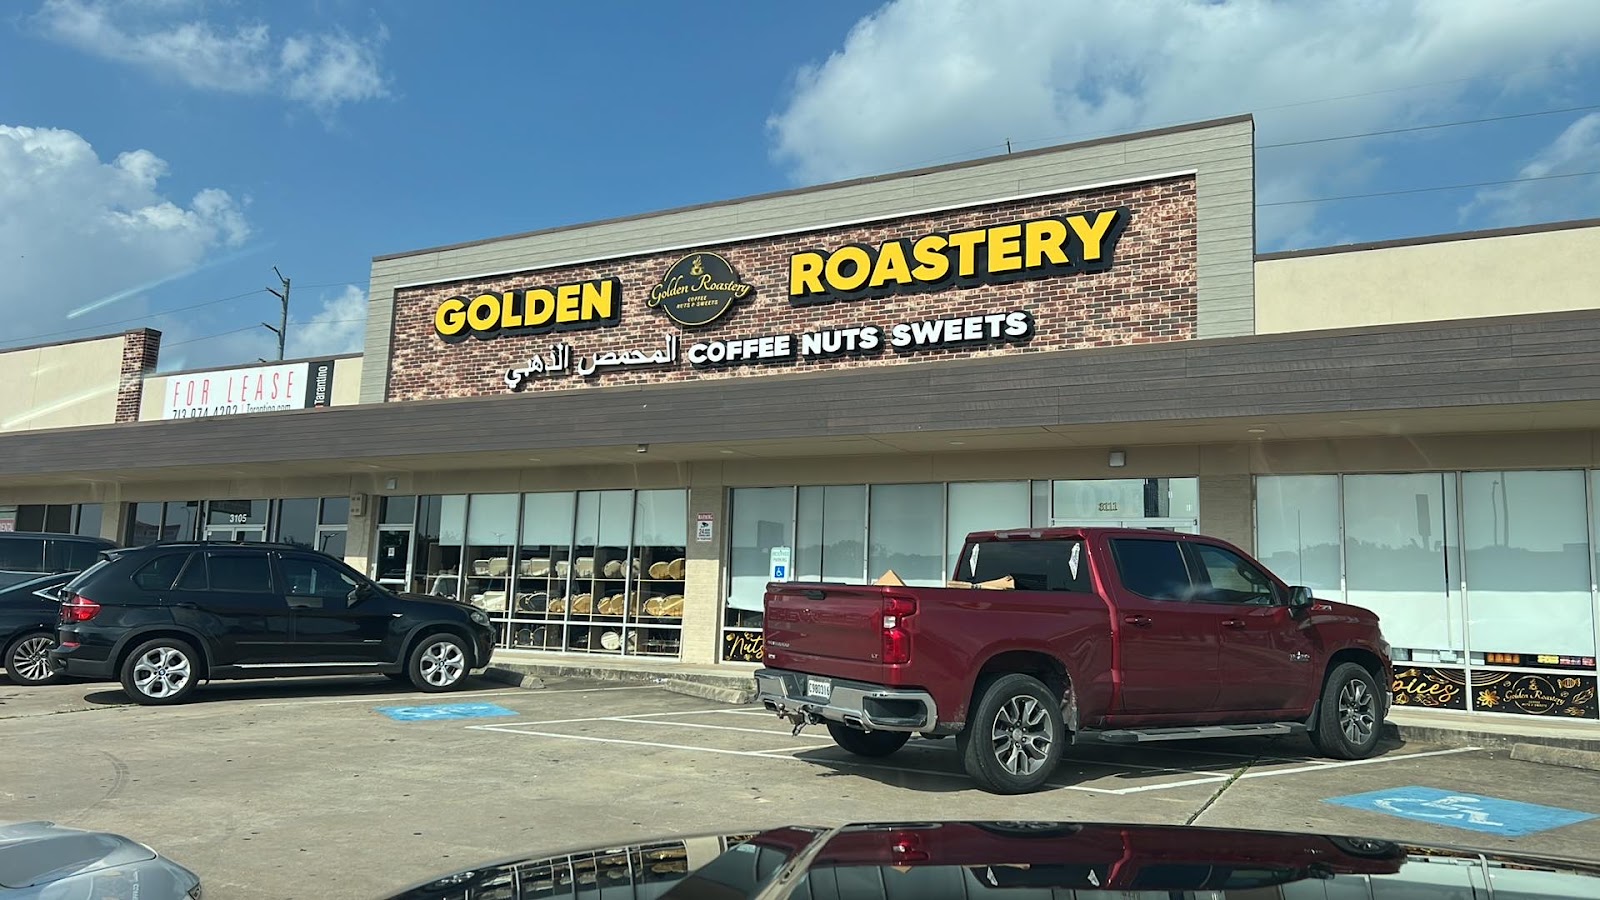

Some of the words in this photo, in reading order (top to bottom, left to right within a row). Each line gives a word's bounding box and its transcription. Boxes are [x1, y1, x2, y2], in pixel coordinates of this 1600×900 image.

[434, 279, 613, 335] GOLDEN
[790, 210, 1118, 296] ROASTERY
[648, 275, 689, 307] Golden
[691, 273, 750, 298] Roastery
[578, 333, 677, 375] المحمص
[688, 334, 790, 364] COFFEE
[802, 326, 879, 355] NUTS
[891, 311, 1028, 346] SWEETS
[504, 342, 570, 389] الذهبي
[173, 379, 210, 408] FOR
[227, 371, 294, 403] LEASE
[314, 365, 328, 405] Tarantino
[229, 513, 247, 523] 3105
[729, 634, 765, 659] Nuts
[1392, 678, 1460, 702] pices
